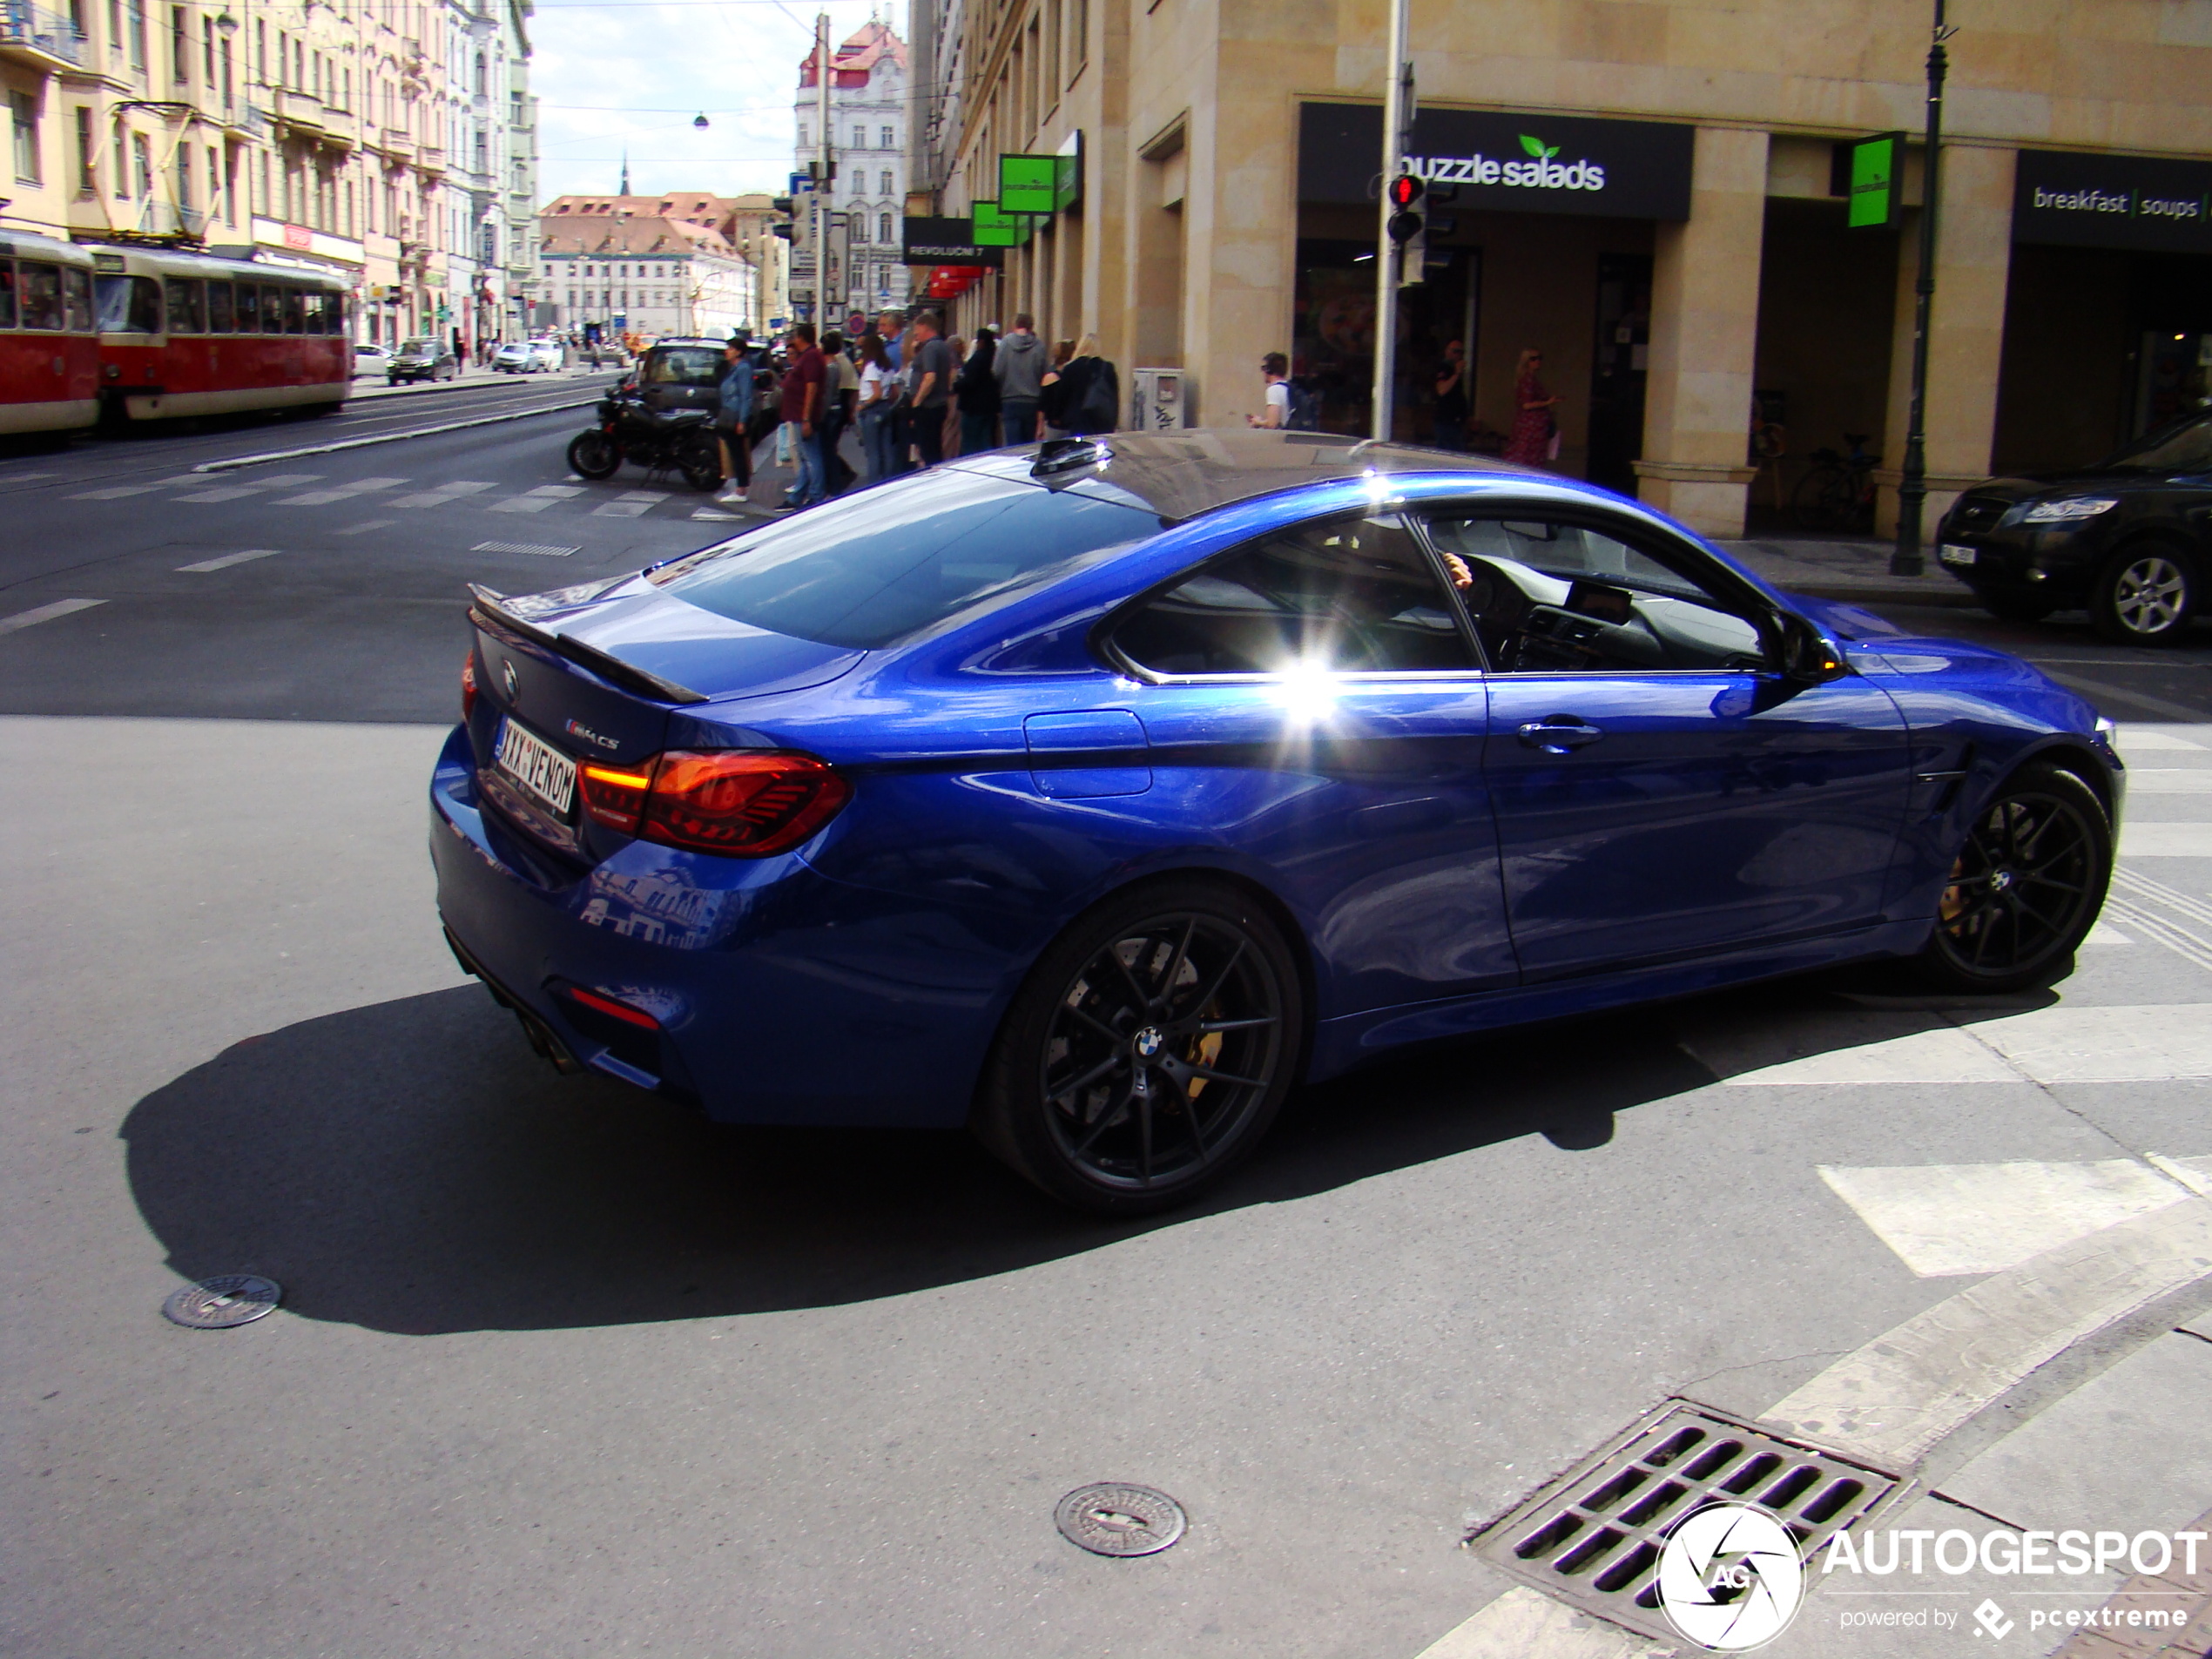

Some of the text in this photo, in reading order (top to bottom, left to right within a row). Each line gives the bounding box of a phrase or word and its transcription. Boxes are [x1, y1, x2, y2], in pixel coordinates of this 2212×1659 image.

[2033, 185, 2200, 221] breakfast soups
[976, 247, 984, 257] 7
[528, 743, 575, 809] VENOM
